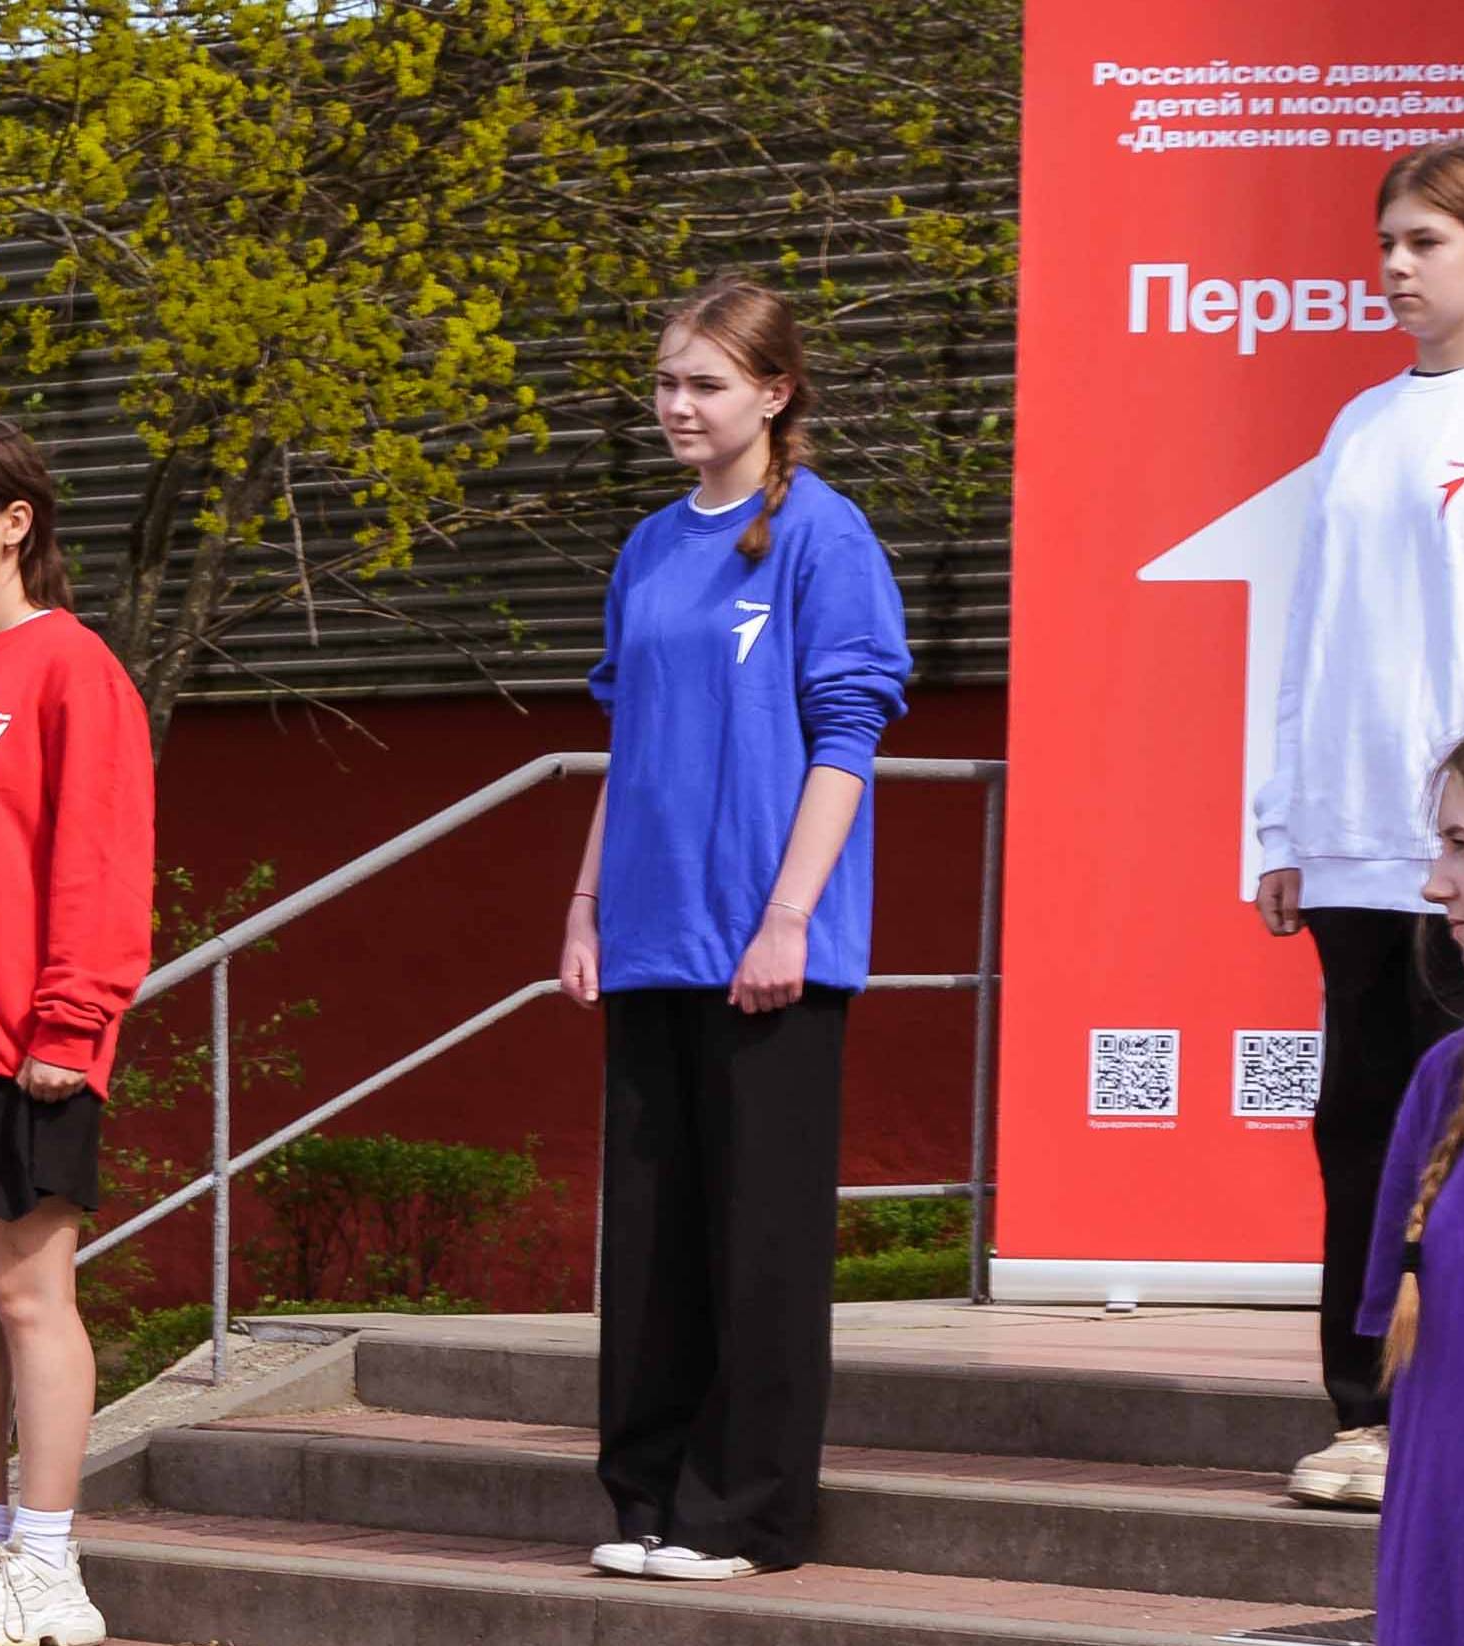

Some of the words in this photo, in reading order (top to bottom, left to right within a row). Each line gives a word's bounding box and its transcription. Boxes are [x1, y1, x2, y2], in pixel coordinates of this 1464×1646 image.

[1092, 60, 1319, 87] Российское
[1130, 91, 1243, 120] детей
[1249, 97, 1273, 117] и
[1117, 124, 1330, 153] «Движение
[1128, 262, 1408, 355] Первы
